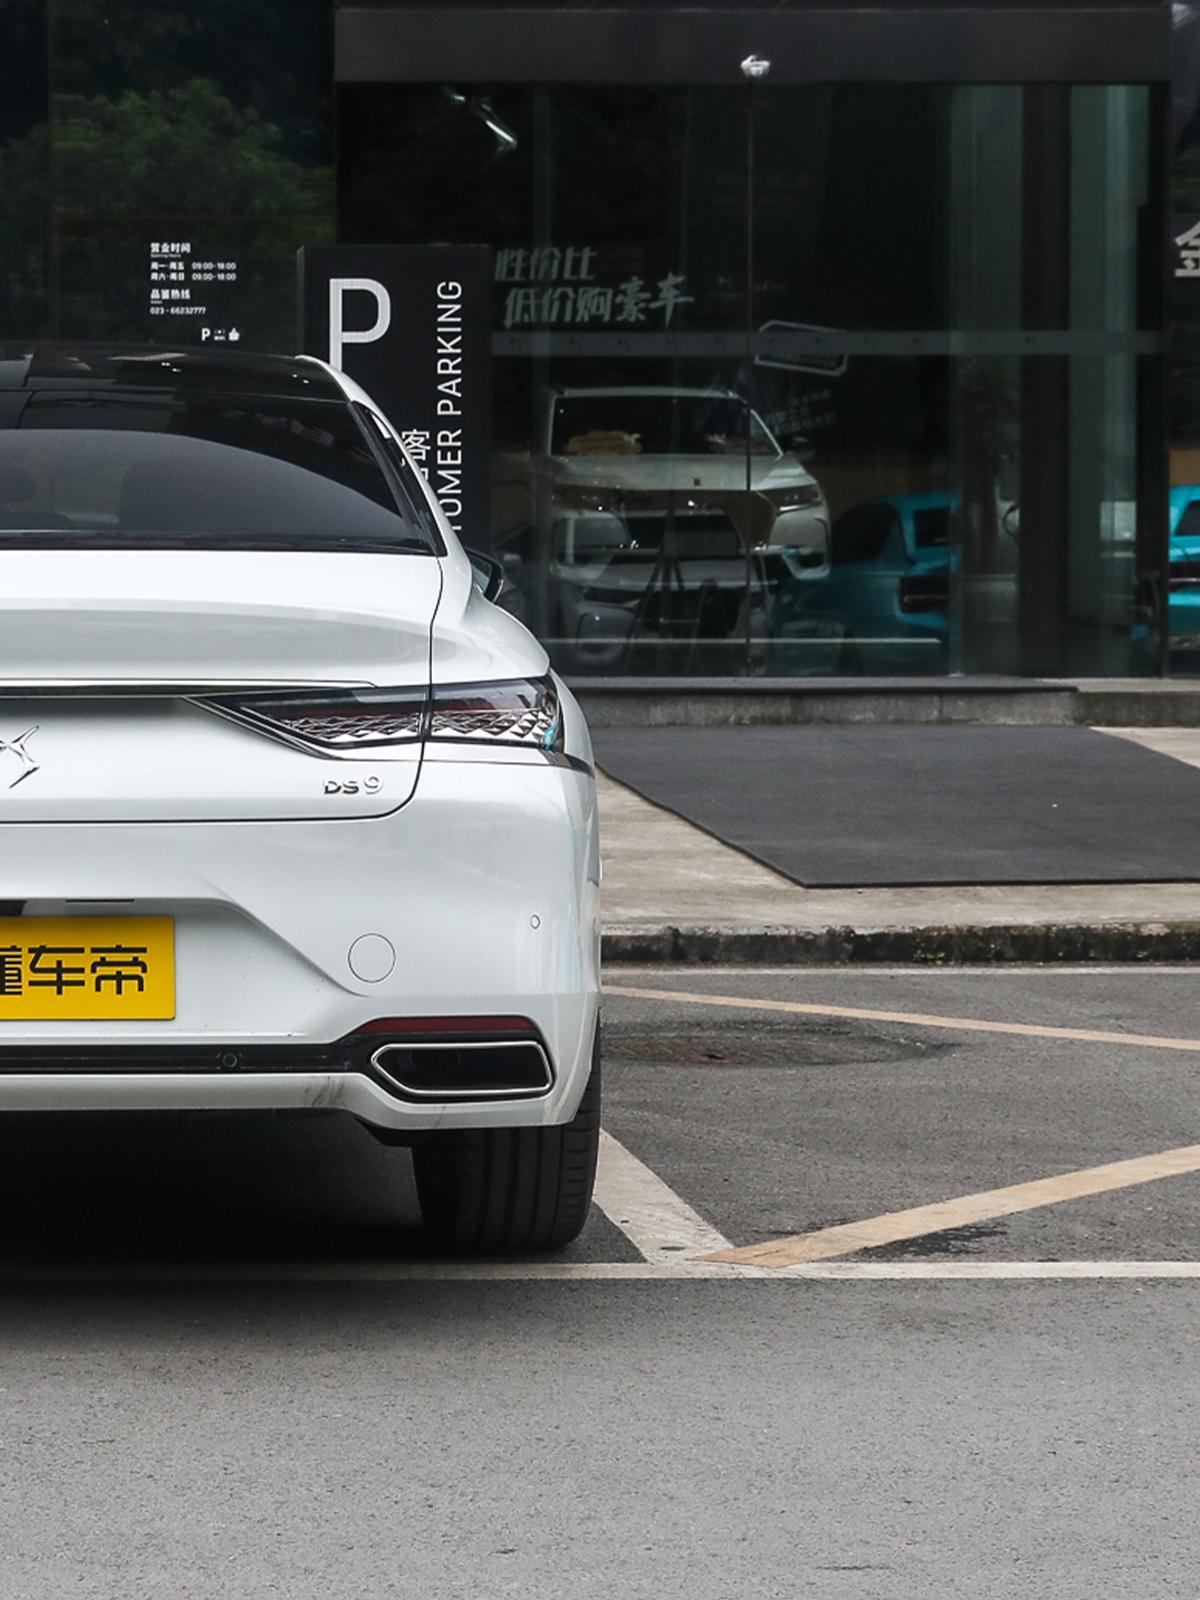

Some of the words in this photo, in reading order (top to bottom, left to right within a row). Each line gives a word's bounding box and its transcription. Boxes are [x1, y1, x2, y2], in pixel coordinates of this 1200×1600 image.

[150, 242, 191, 254] 营业时间
[494, 246, 599, 281] 性价比
[503, 272, 695, 329] 低价购豪车
[201, 327, 211, 341] P
[329, 277, 391, 373] P
[437, 280, 462, 416] PARKING
